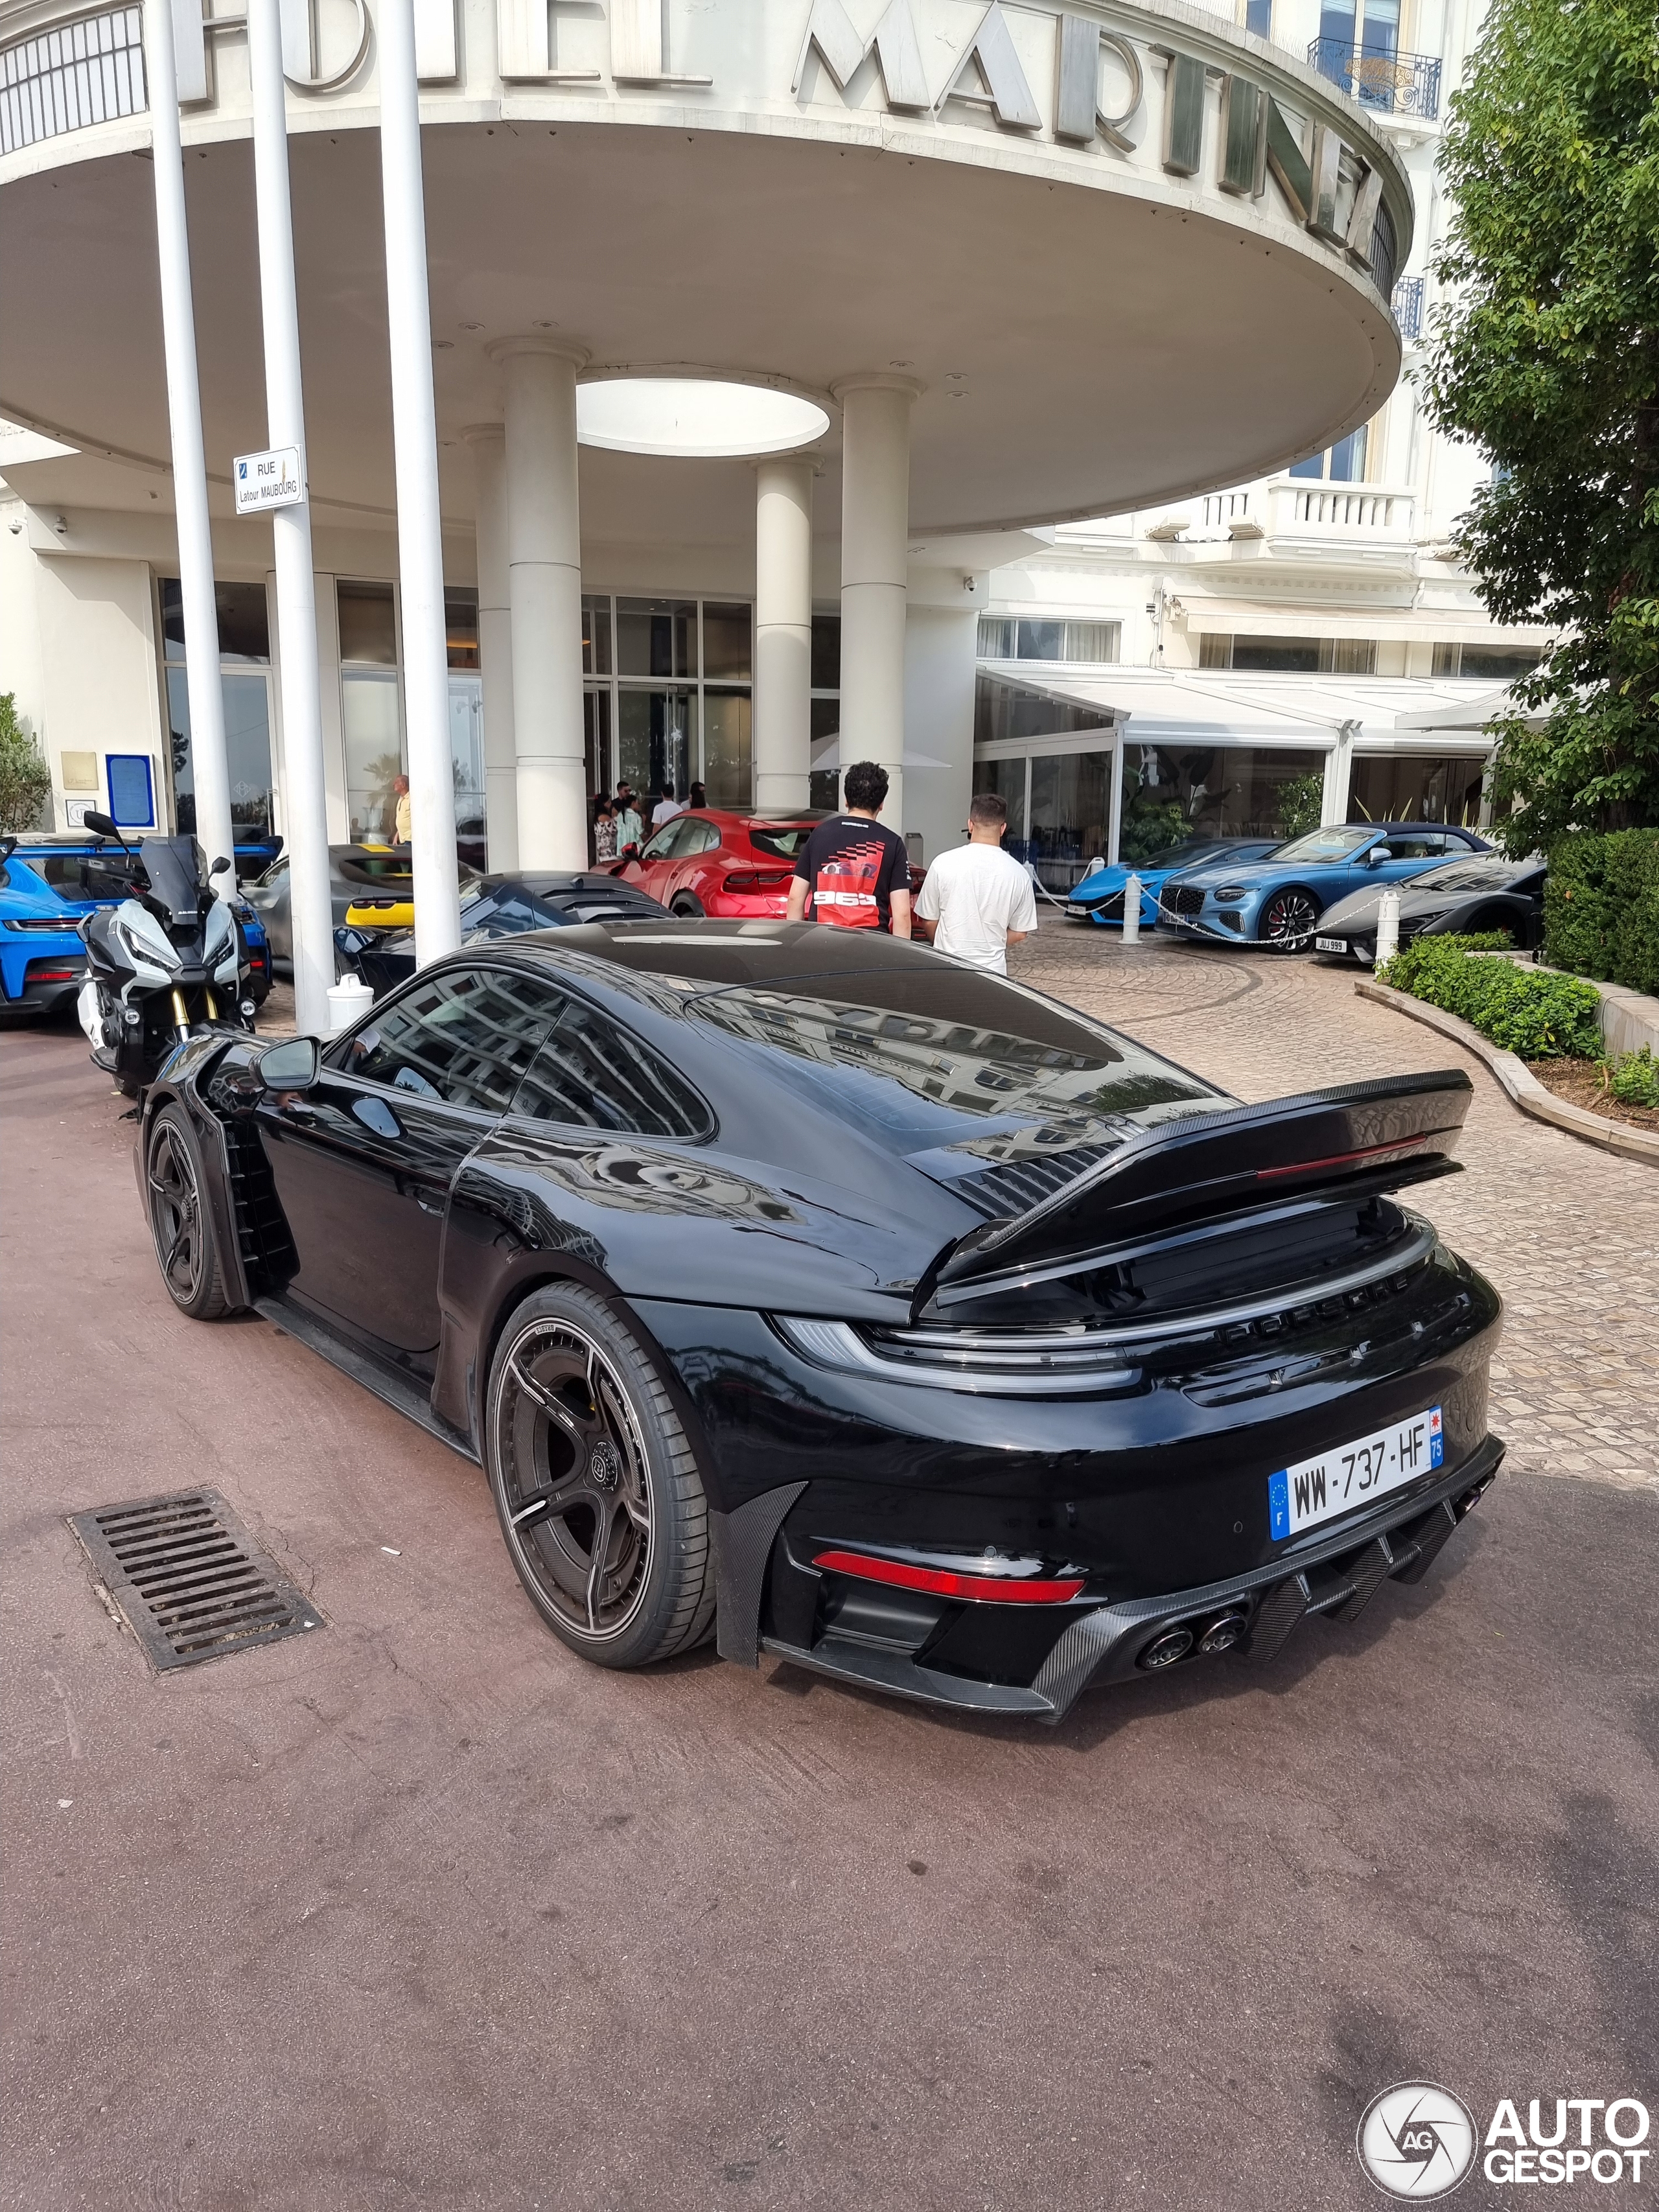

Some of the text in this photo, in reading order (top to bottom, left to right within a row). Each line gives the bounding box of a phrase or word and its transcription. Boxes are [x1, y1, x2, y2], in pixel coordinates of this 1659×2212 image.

[790, 0, 1384, 272] MARTINEZ
[257, 461, 276, 476] RUE
[240, 480, 297, 502] Latour MAUBOURG
[1319, 940, 1342, 950] JUJ 999
[1432, 1438, 1442, 1460] 75
[1277, 1423, 1425, 1526] F WW-737-HF
